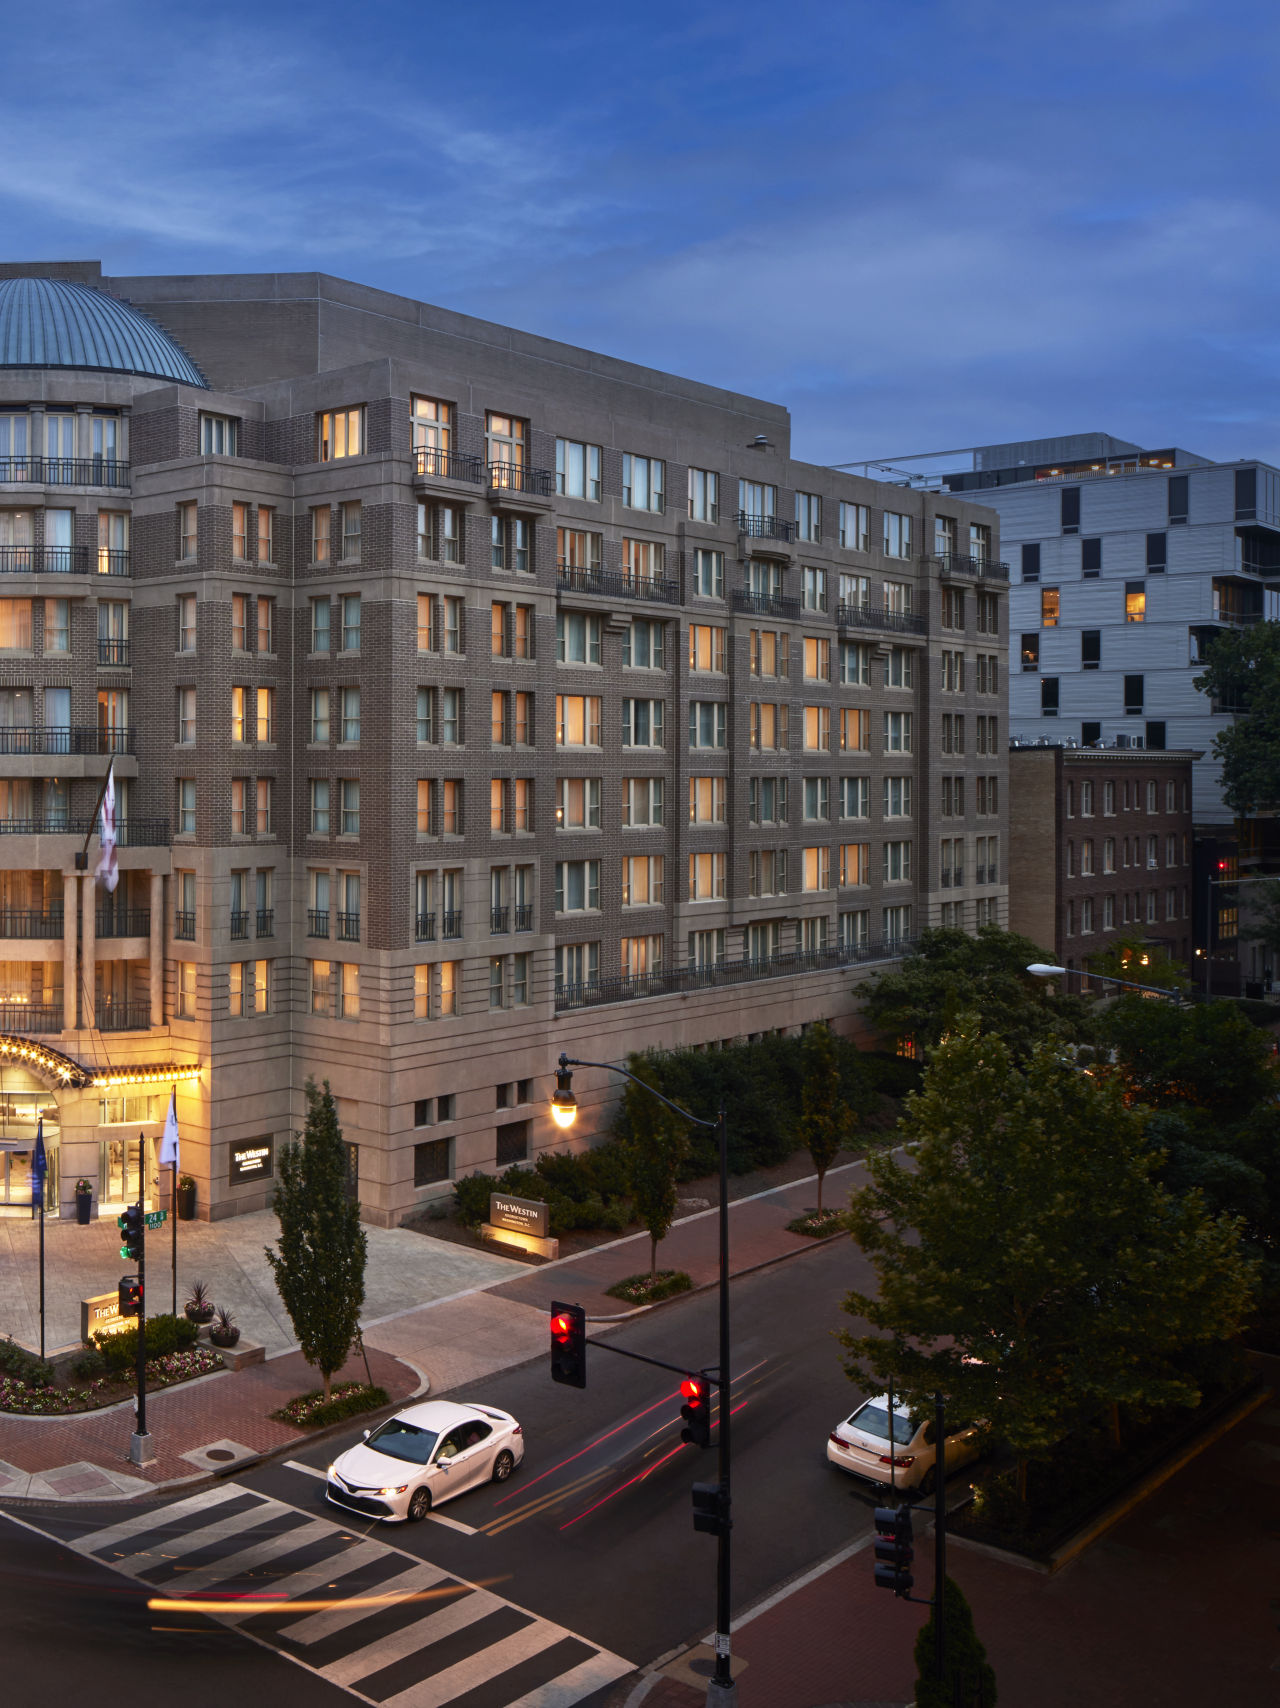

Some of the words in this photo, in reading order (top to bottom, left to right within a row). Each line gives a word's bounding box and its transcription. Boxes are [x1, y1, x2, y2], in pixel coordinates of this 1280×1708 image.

[496, 1201, 510, 1212] THE
[510, 1204, 538, 1218] WESTIN
[94, 1308, 109, 1318] THE
